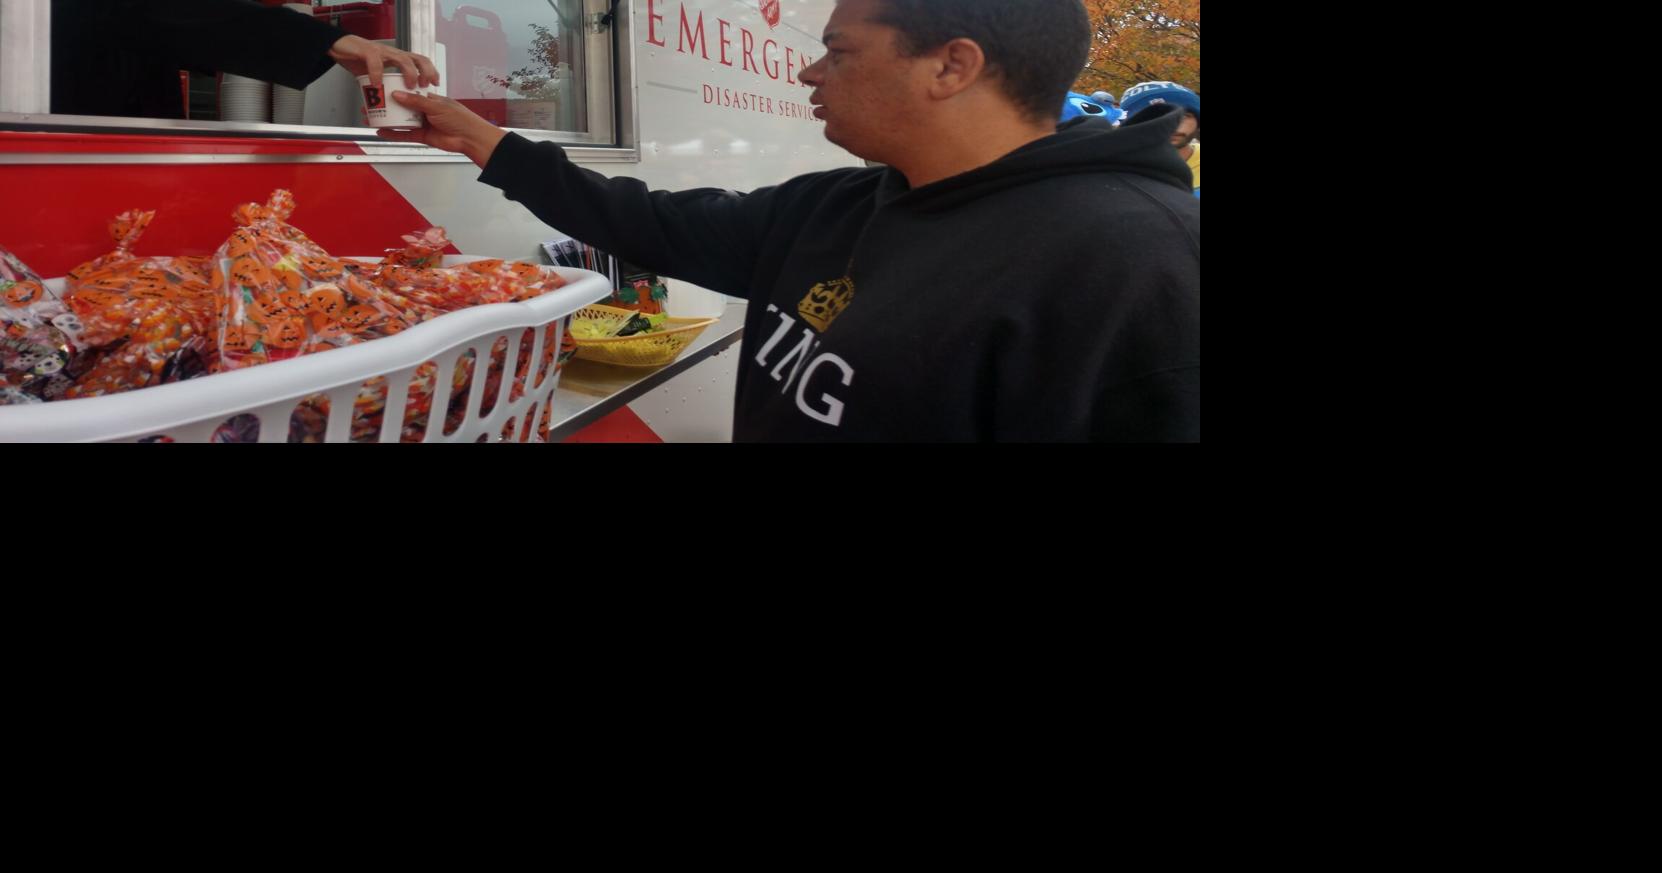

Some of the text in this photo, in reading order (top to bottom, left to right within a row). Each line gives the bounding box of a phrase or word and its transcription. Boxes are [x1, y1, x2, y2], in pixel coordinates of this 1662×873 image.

[366, 87, 382, 109] B
[703, 83, 823, 121] DISASTER SERVIC
[755, 303, 854, 427] ING
